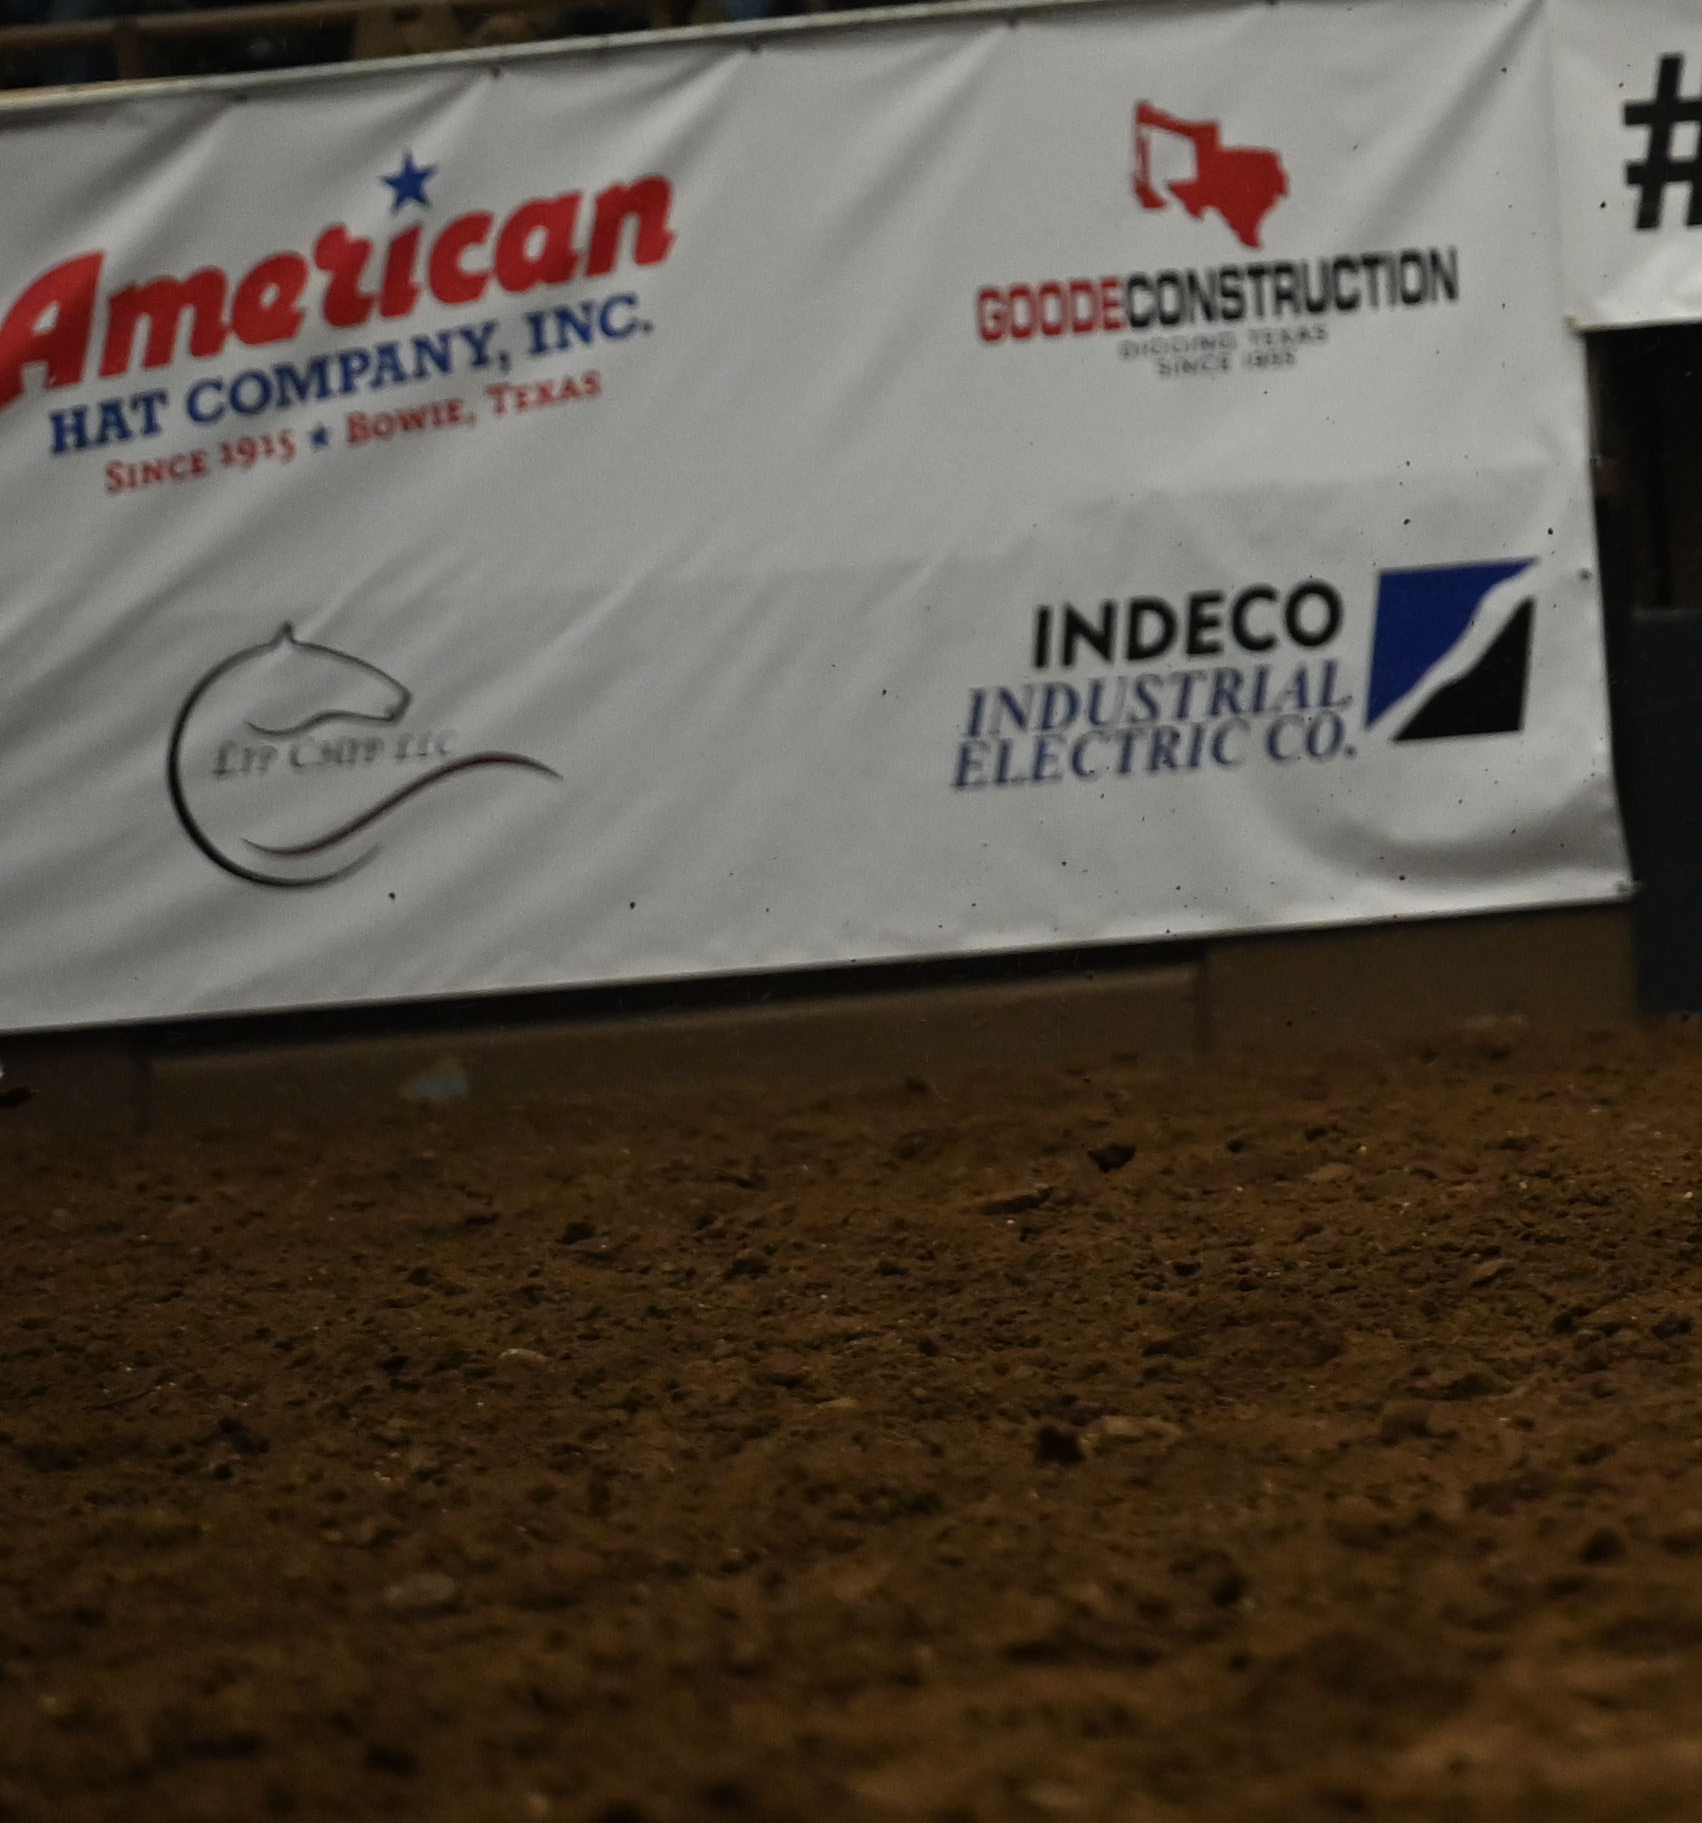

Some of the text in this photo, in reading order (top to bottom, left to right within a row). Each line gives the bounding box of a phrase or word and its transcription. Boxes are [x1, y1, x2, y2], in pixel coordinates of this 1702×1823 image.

[0, 175, 677, 411] American
[50, 294, 654, 456] HAT COMPANY, INC.
[105, 370, 604, 495] SINCE 1915 BOWIE, TEXAS
[1033, 580, 1344, 668] INDECO
[953, 707, 1358, 791] ELECTRIC CO.
[964, 658, 1354, 739] INDUSTRIAL
